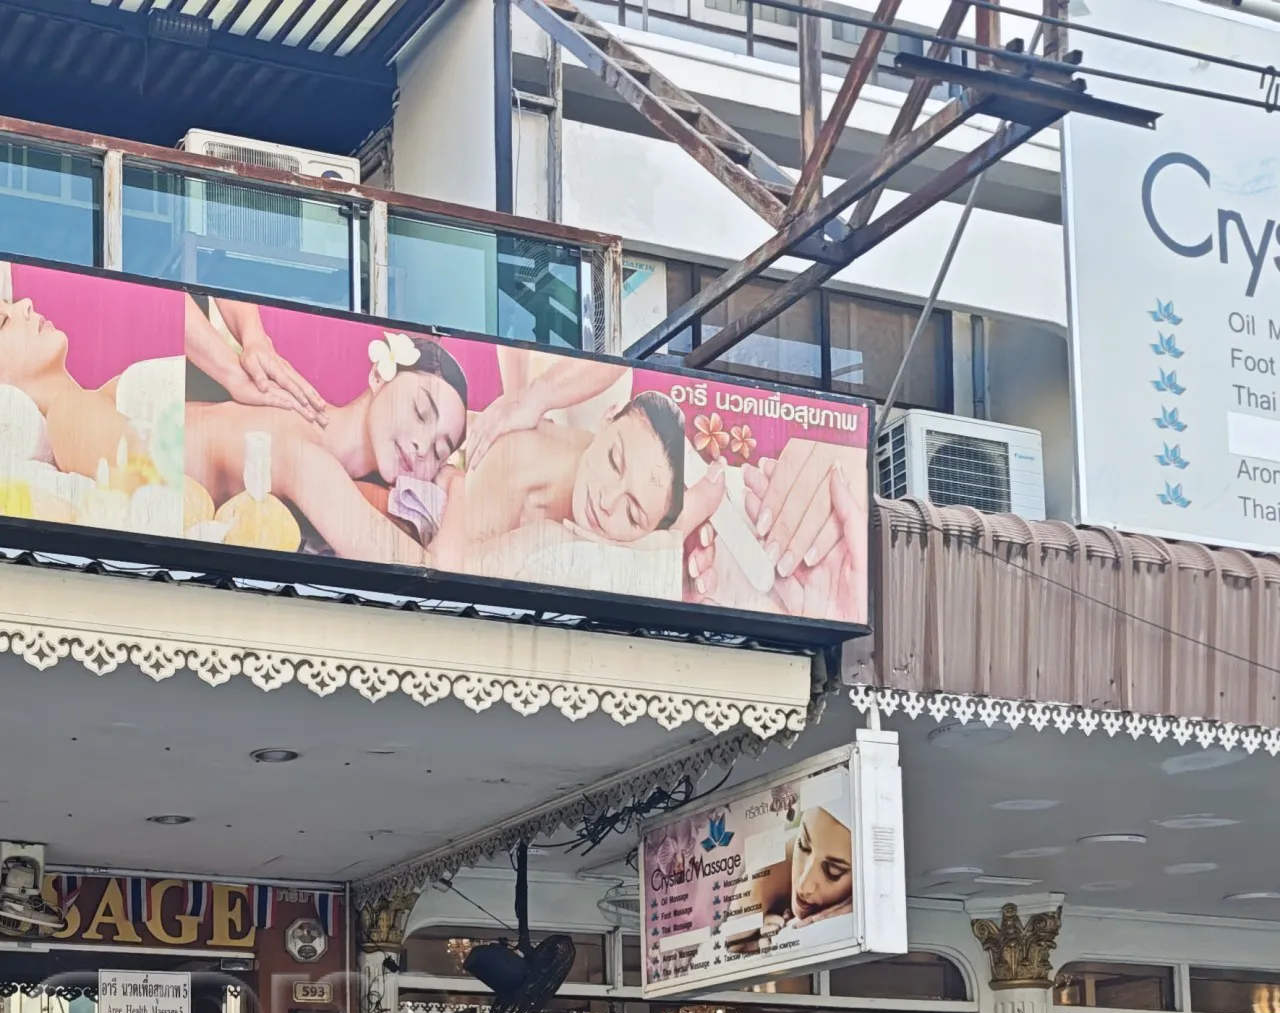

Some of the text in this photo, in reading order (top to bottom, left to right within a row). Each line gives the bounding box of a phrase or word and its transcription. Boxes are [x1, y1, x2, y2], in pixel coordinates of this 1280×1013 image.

[1142, 152, 1280, 297] Cry
[1228, 312, 1256, 337] Oil
[1230, 348, 1276, 376] Foot
[670, 384, 858, 431] อารี นวดเพื่อสุขภาพ
[1232, 384, 1276, 413] Thai
[1236, 460, 1280, 485] Aro
[101, 975, 188, 1004] อารี นวดเพื่อสุขภาพ 5
[301, 986, 325, 998] 593
